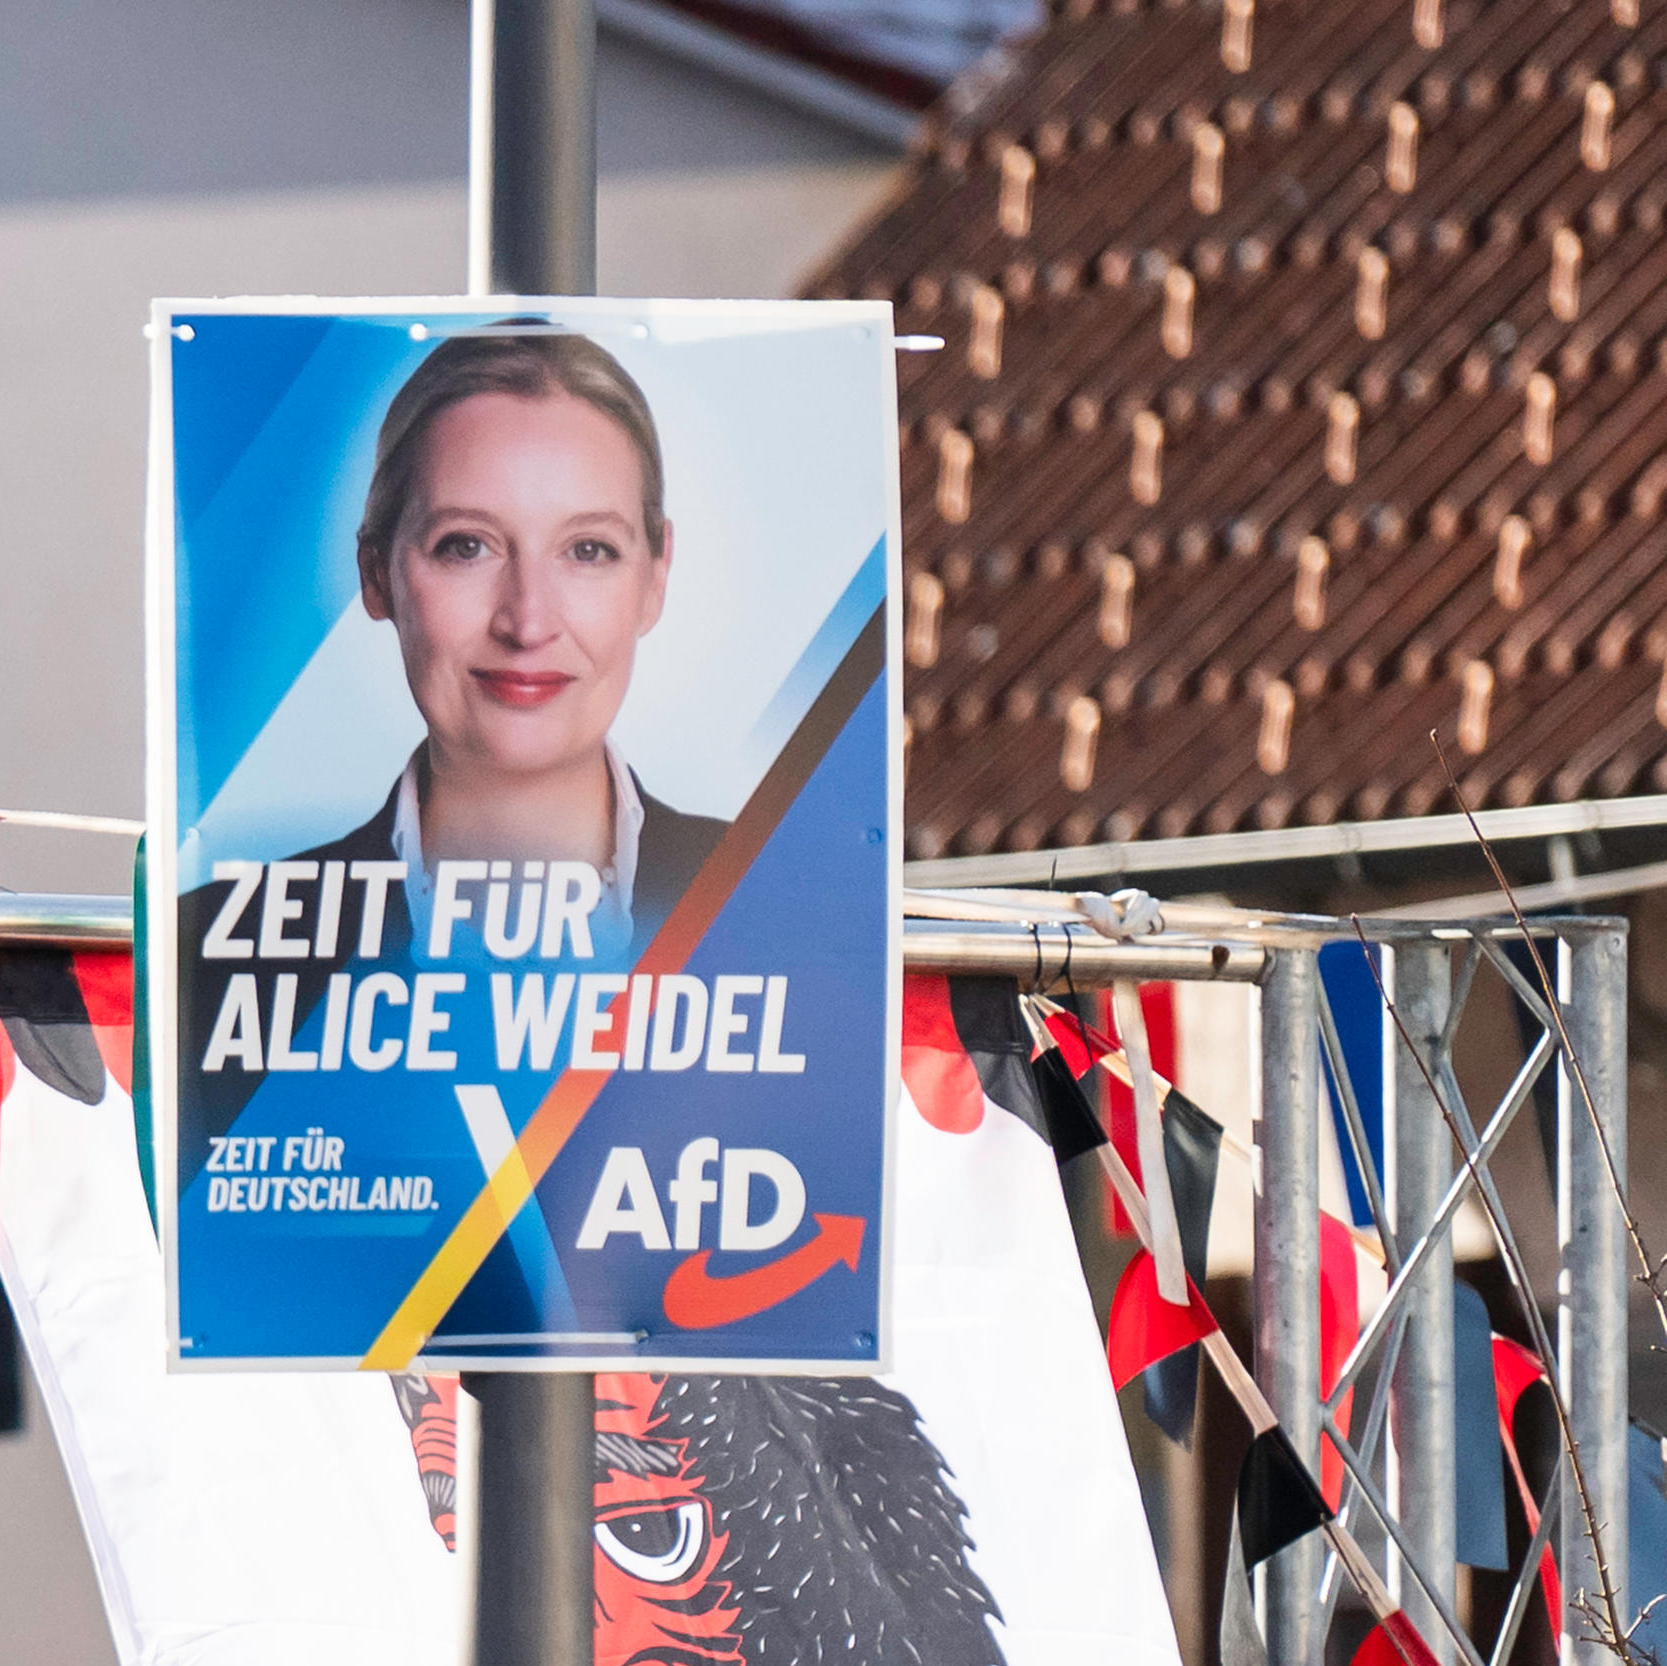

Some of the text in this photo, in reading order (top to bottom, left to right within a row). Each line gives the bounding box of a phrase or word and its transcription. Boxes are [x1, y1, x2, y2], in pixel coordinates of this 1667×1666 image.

[202, 860, 601, 959] ZEIT FÜR
[202, 972, 807, 1075] ALICE WEIDEL
[206, 1127, 345, 1173] ZEIT FÜR
[207, 1175, 440, 1213] DEUTSCHLAND.
[576, 1136, 807, 1252] AfD
